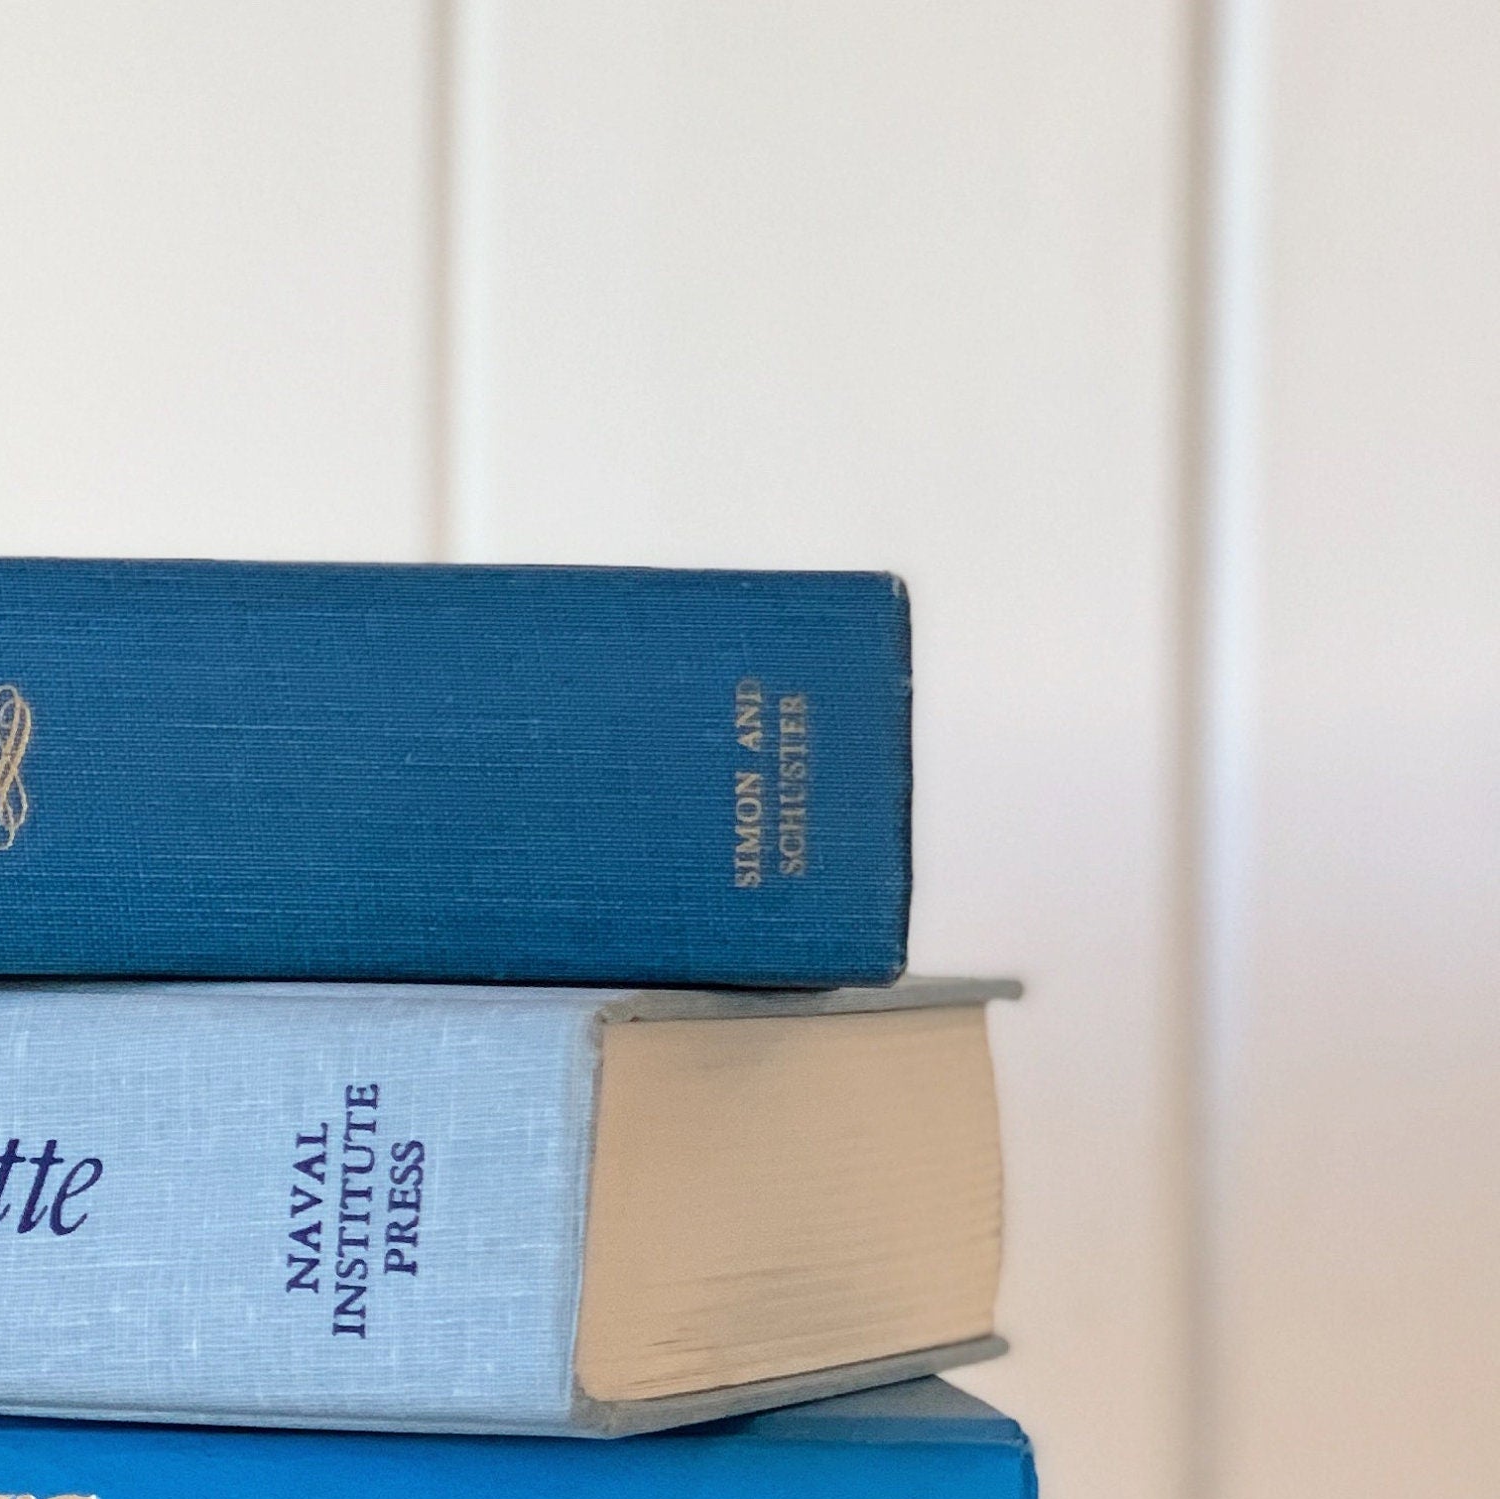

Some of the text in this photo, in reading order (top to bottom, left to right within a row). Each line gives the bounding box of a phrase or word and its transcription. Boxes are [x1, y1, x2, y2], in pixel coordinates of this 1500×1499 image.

[734, 676, 763, 888] SIMON AND
[779, 693, 808, 876] SCHUSTER
[286, 1122, 330, 1293] NAVAL
[332, 1083, 379, 1339] INSTITUTE
[386, 1140, 426, 1278] PRESS
